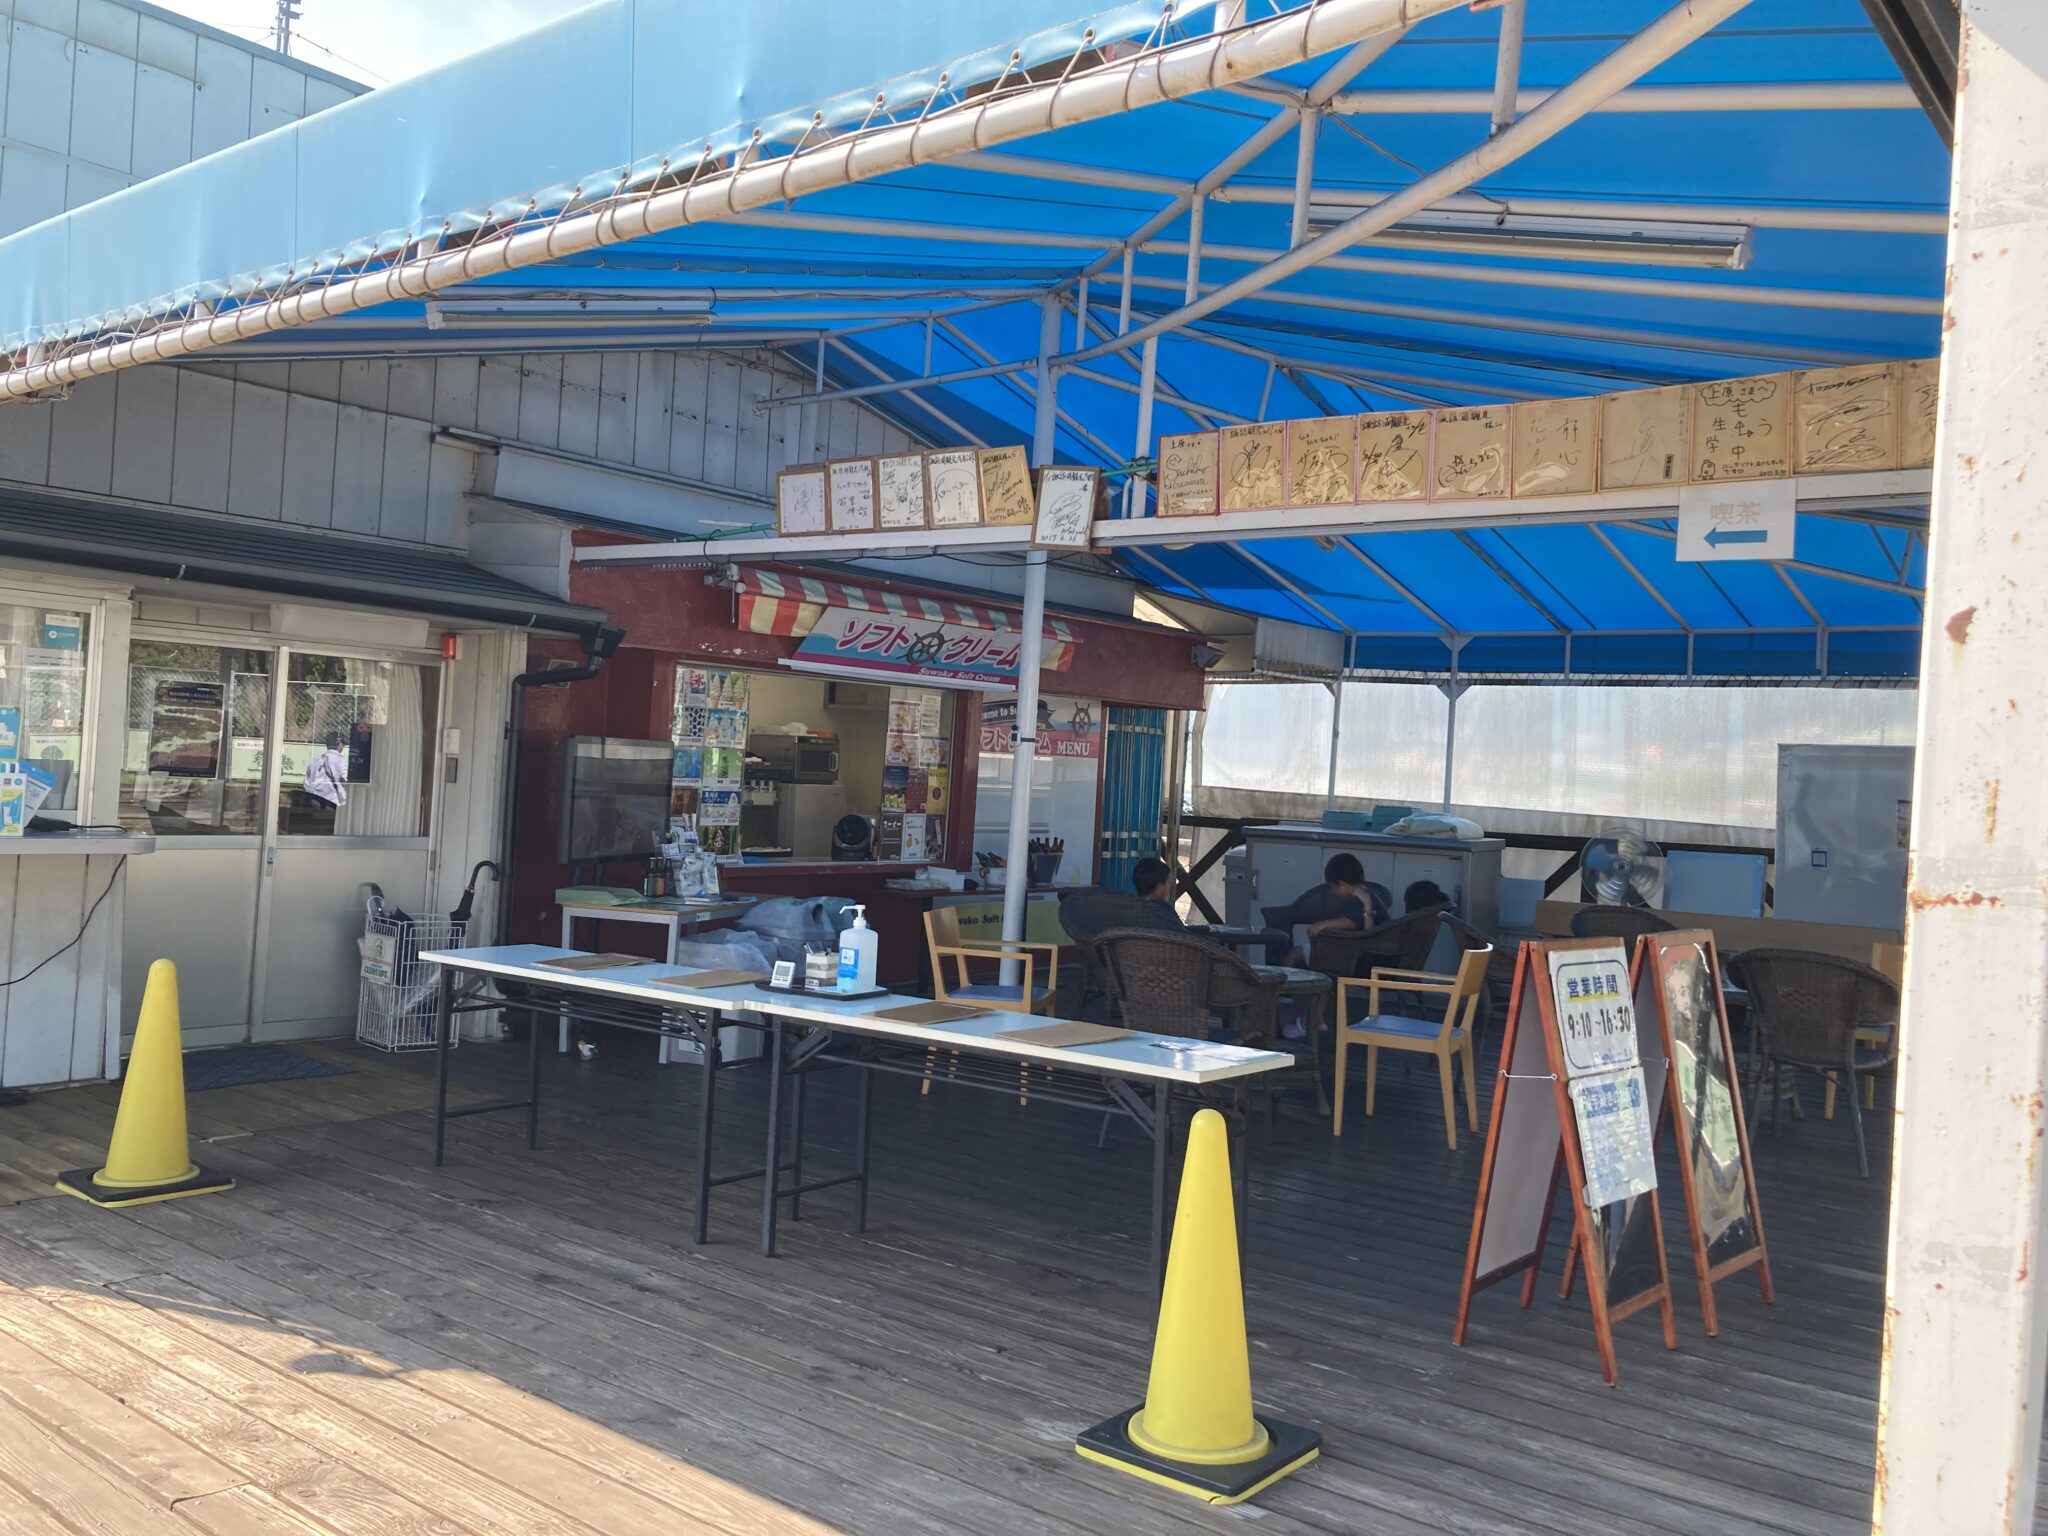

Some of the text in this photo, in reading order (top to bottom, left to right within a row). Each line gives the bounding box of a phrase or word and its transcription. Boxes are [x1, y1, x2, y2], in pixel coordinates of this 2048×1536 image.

[1710, 501, 1761, 526] 喫茶
[1000, 707, 1008, 716] to
[1057, 740, 1090, 756] MENU
[982, 914, 999, 924] Soft
[1567, 974, 1618, 998] 営業時間
